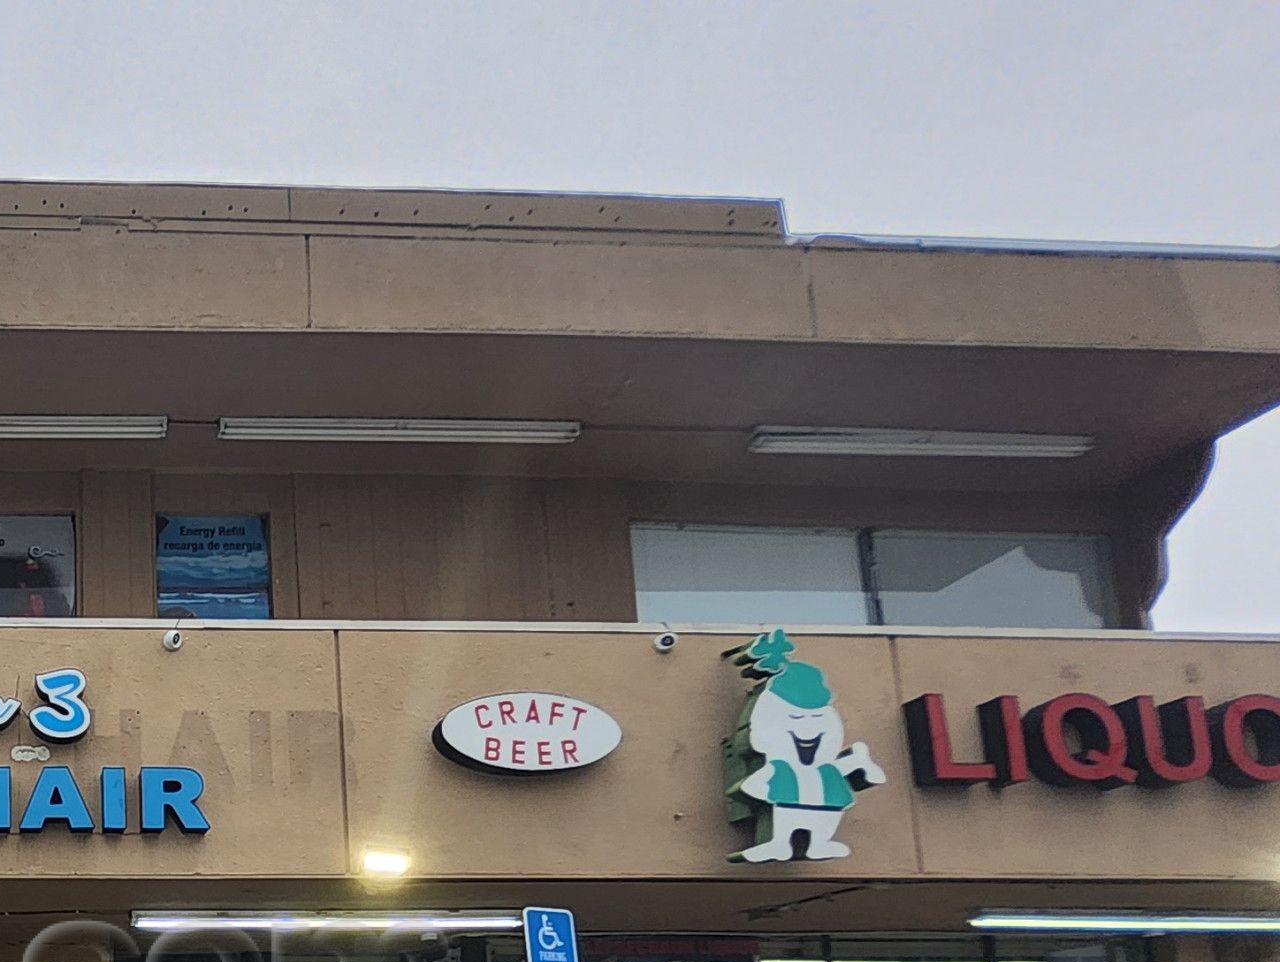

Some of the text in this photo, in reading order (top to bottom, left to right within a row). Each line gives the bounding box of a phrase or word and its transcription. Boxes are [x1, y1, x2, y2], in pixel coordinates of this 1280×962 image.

[164, 541, 204, 552] recarga
[208, 540, 221, 550] de
[179, 526, 246, 539] Energy Refill
[29, 668, 91, 740] 3
[474, 699, 588, 729] CRAFT
[484, 737, 579, 765] BEER
